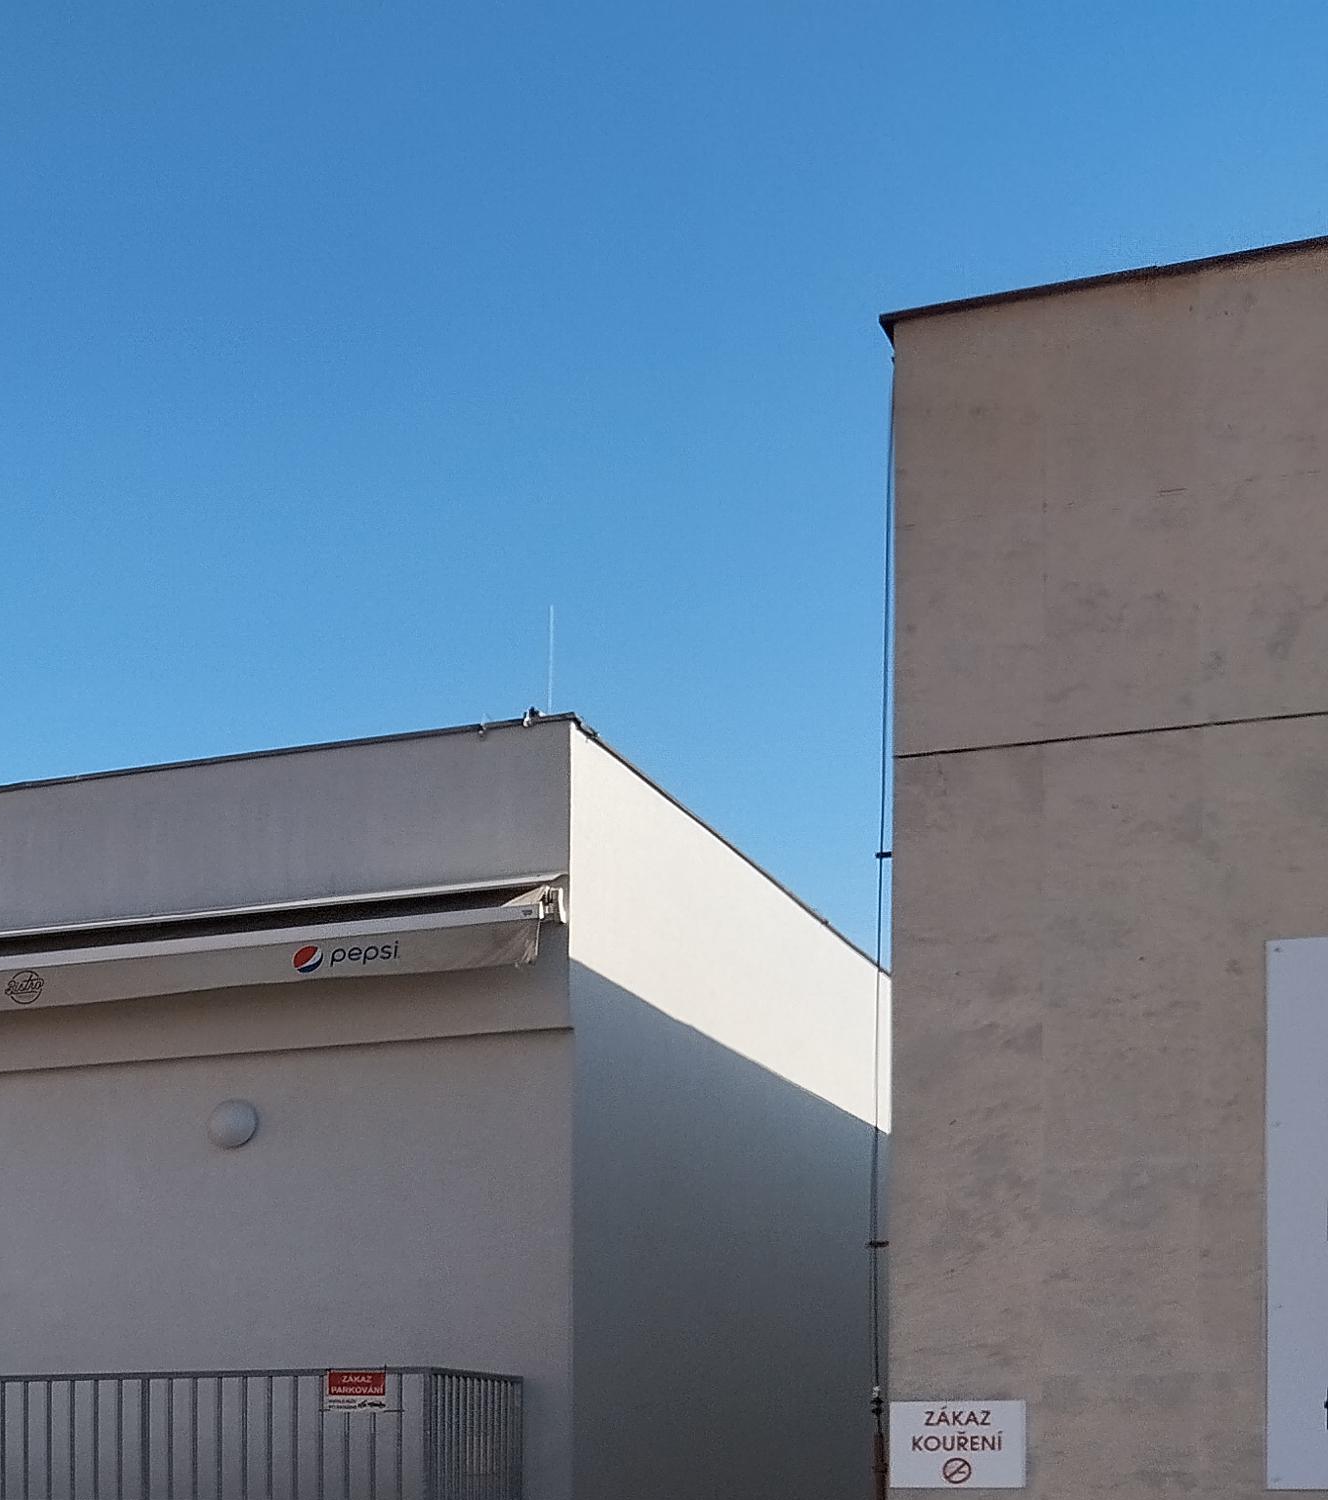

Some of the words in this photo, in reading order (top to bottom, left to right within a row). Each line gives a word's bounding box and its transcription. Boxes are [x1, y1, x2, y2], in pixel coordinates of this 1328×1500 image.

[330, 940, 400, 968] pepsi
[330, 1383, 384, 1394] PARKOVÁNÍ
[925, 1406, 992, 1426] ZÁKAZ
[911, 1430, 1004, 1452] KOUŘENÍ
